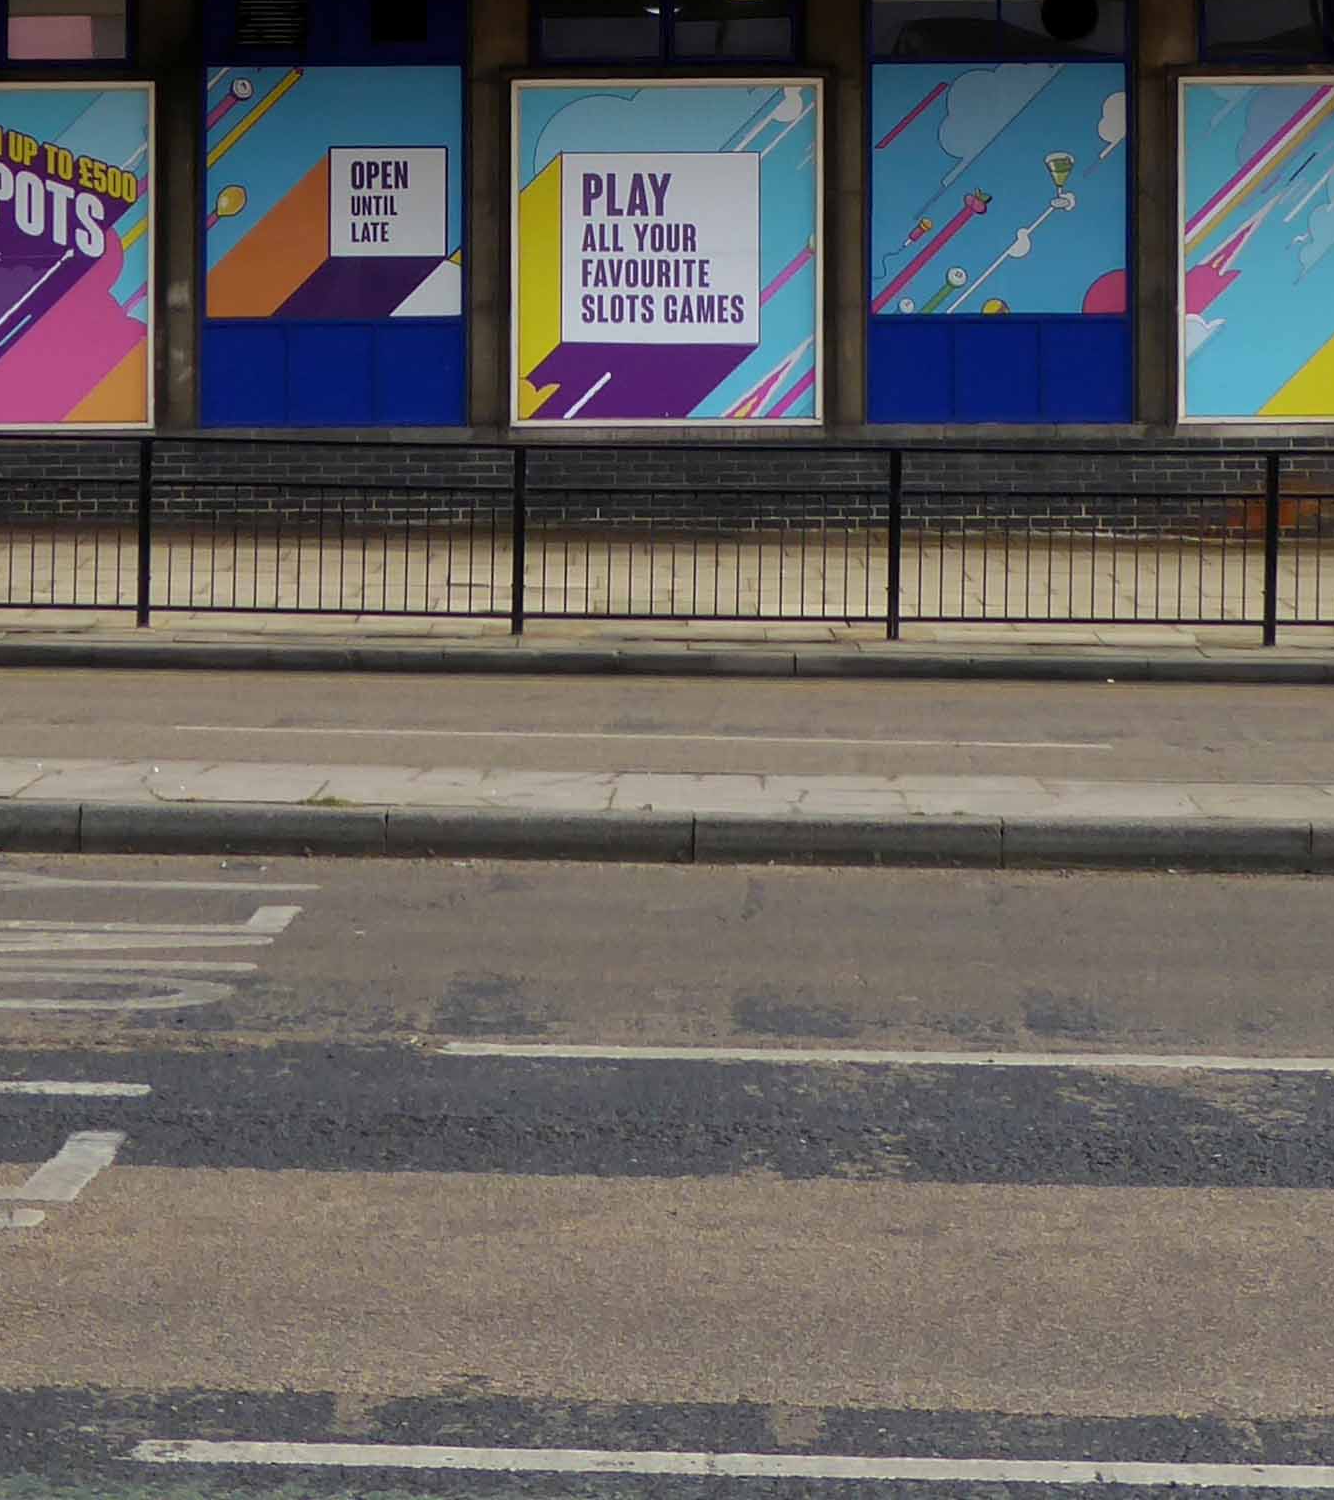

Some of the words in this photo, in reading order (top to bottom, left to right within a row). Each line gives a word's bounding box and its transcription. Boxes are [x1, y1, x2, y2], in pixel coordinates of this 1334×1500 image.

[9, 130, 38, 167] UP
[44, 143, 73, 181] TO
[78, 157, 137, 203] £500
[351, 160, 409, 190] OPEN
[351, 195, 398, 217] UNTIL
[582, 173, 672, 217] PLAY
[351, 222, 390, 243] LATE
[581, 223, 624, 252] ALL
[633, 223, 697, 252] YOUR
[581, 259, 710, 288] FAVOURITE
[581, 294, 655, 324] SLOTS
[664, 294, 745, 324] GAMES
